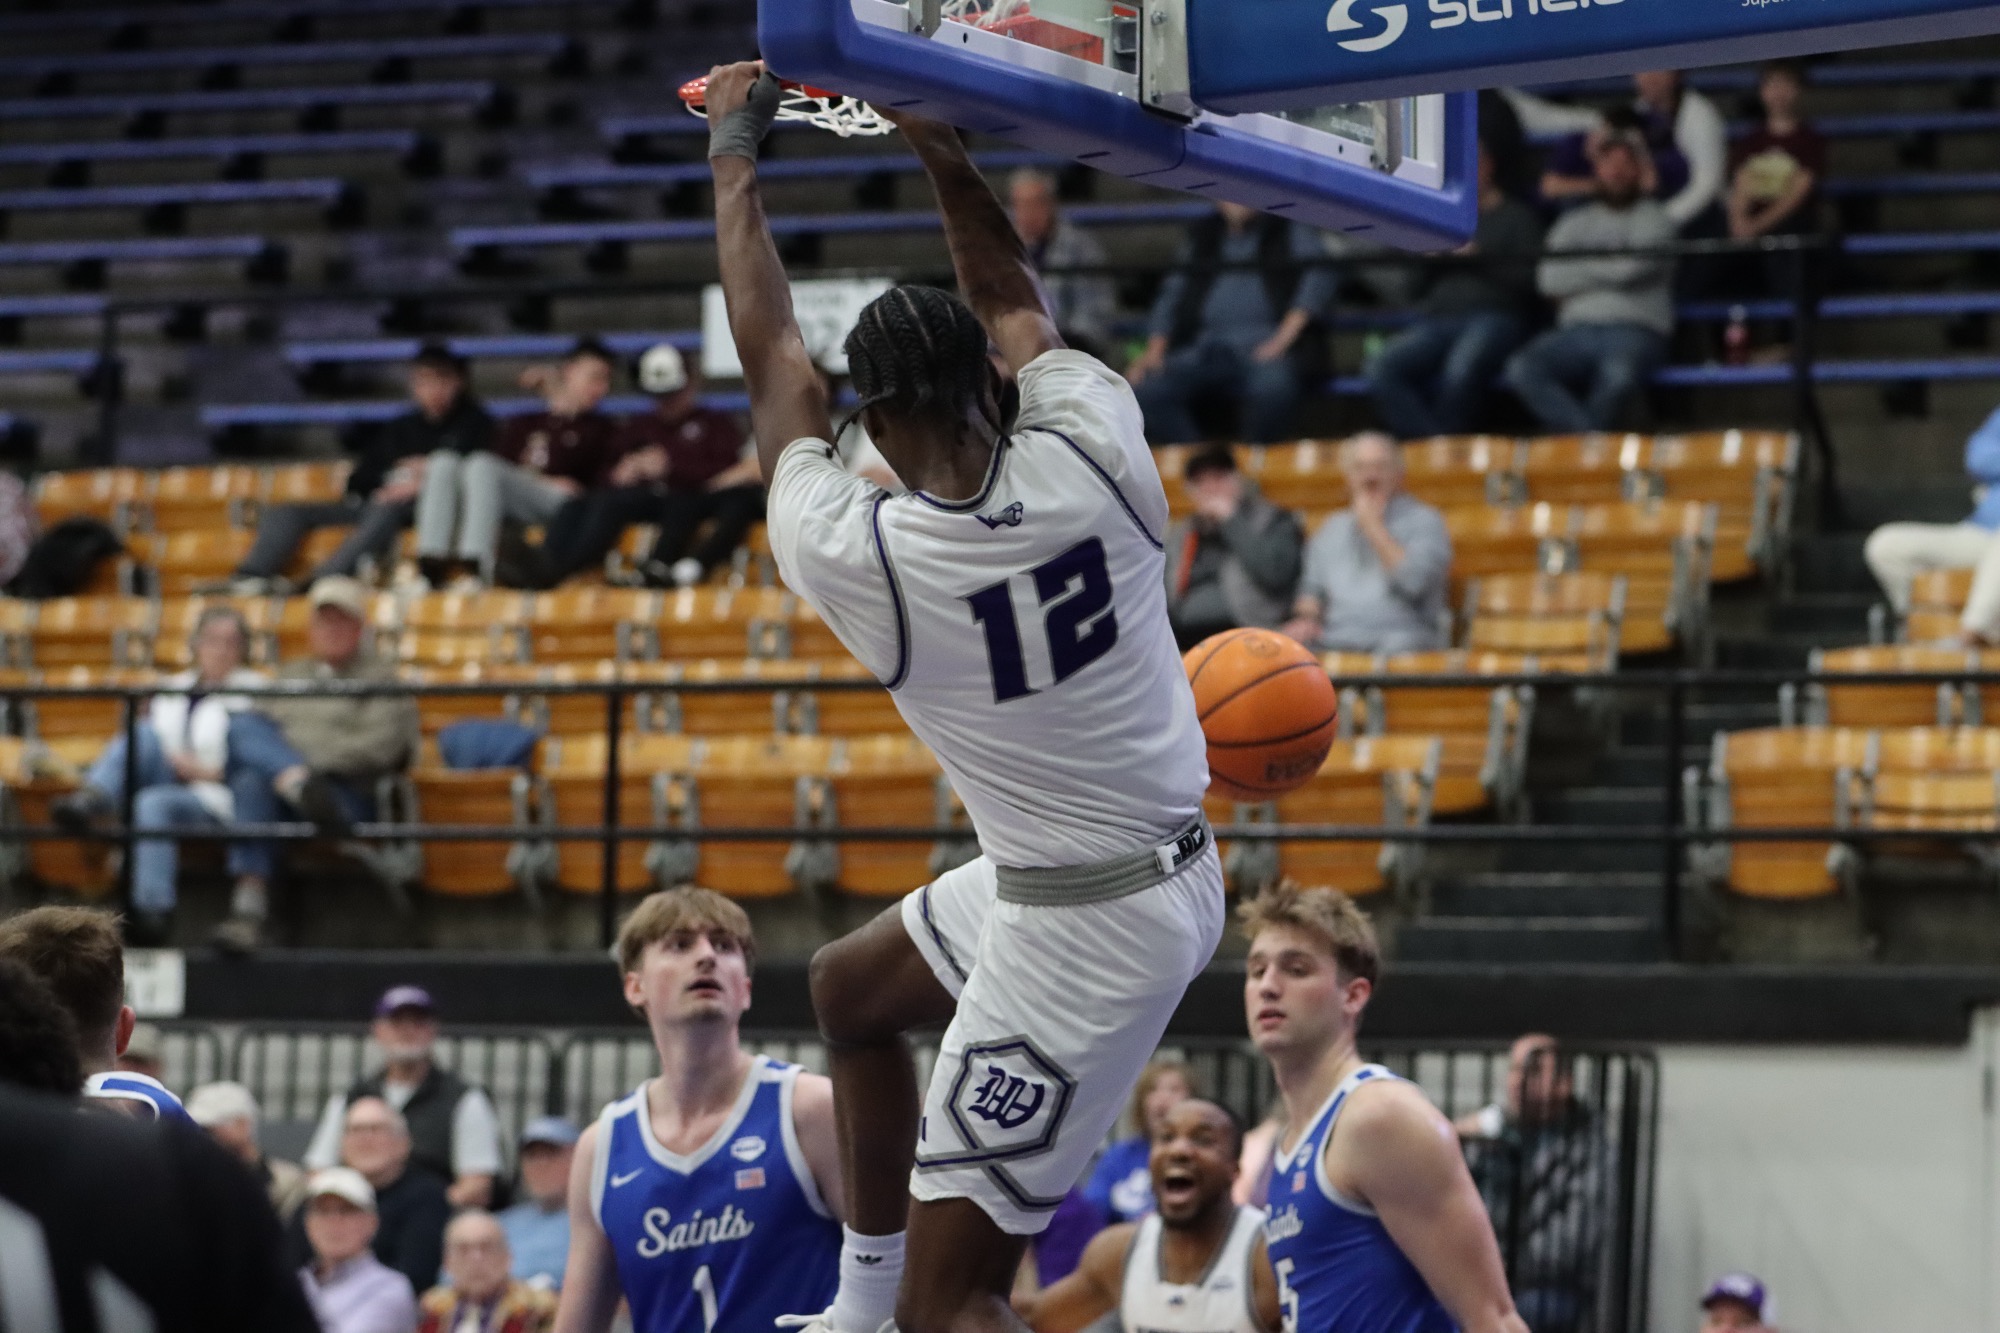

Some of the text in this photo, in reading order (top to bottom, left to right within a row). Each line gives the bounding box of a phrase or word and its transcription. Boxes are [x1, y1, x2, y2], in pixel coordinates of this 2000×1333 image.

[955, 535, 1119, 705] 12
[636, 1203, 755, 1258] Saints
[691, 1264, 719, 1333] 1
